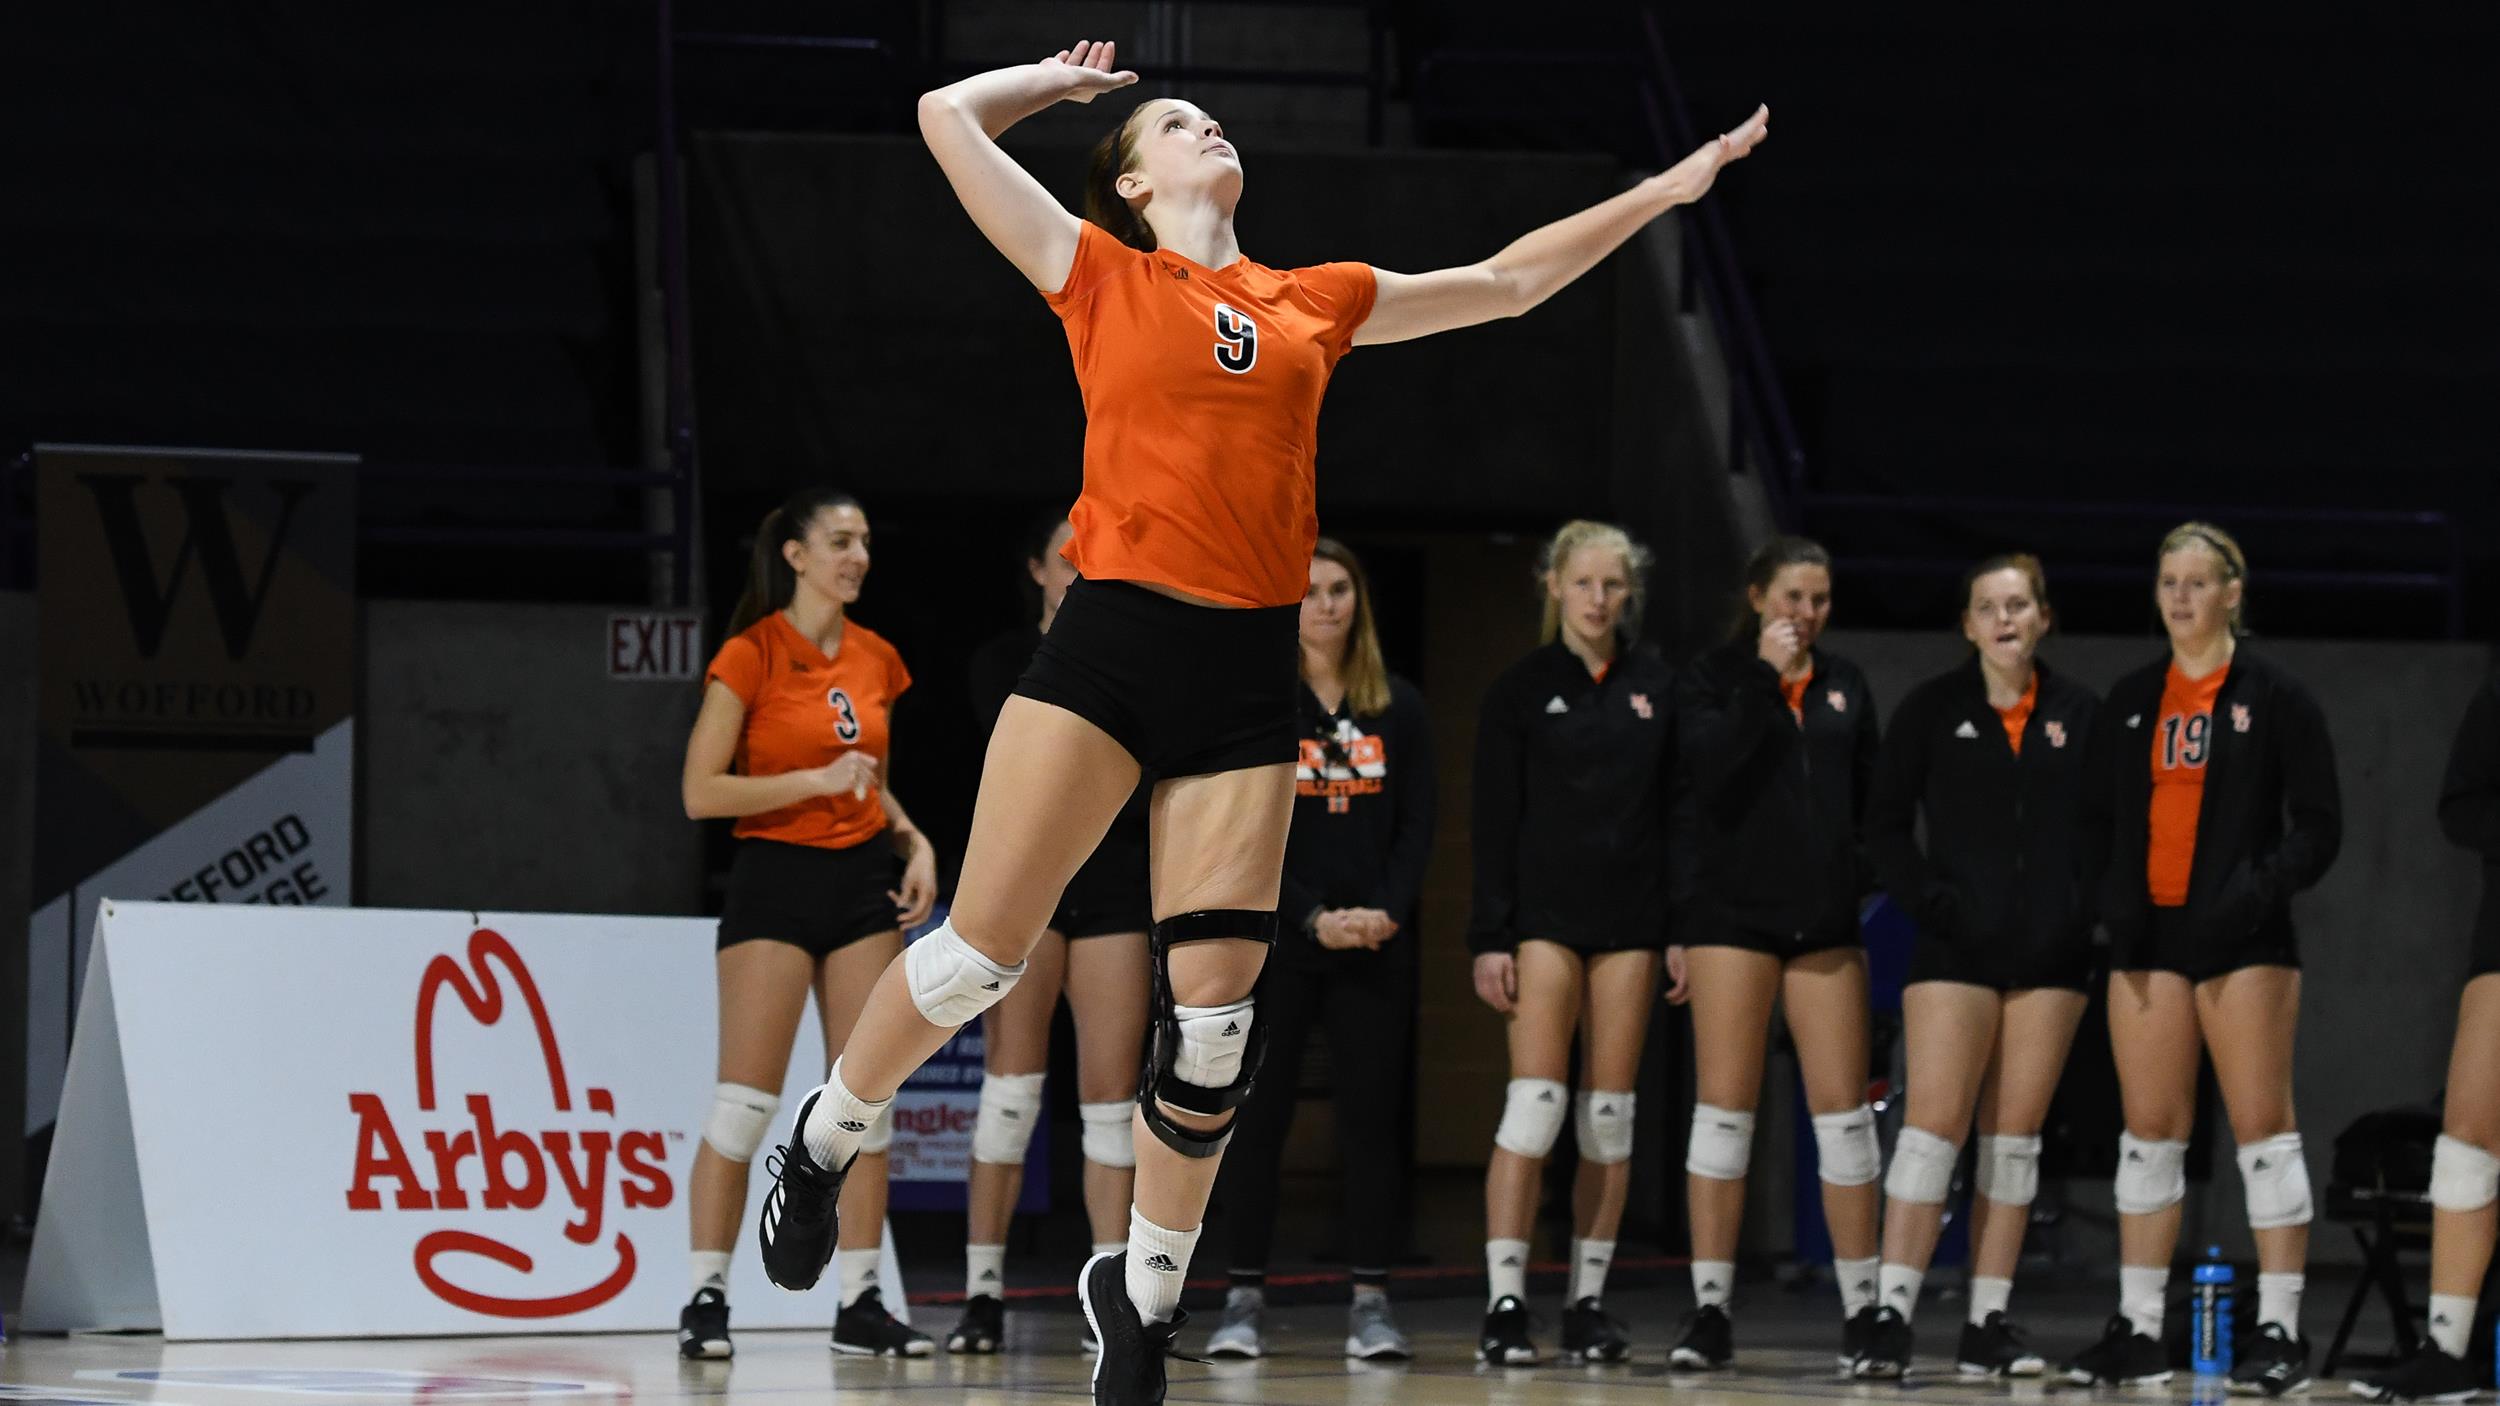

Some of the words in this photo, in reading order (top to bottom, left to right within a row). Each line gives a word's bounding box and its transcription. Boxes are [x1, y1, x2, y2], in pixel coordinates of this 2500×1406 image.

[1214, 303, 1257, 374] 9
[76, 473, 317, 660] W
[612, 618, 697, 674] EXIT
[72, 679, 316, 720] WOFFORD
[828, 687, 861, 744] 3
[2162, 711, 2212, 769] 19
[156, 814, 310, 903] FFORD
[346, 1088, 674, 1245] Arby's
[1144, 1258, 1178, 1272] adidas
